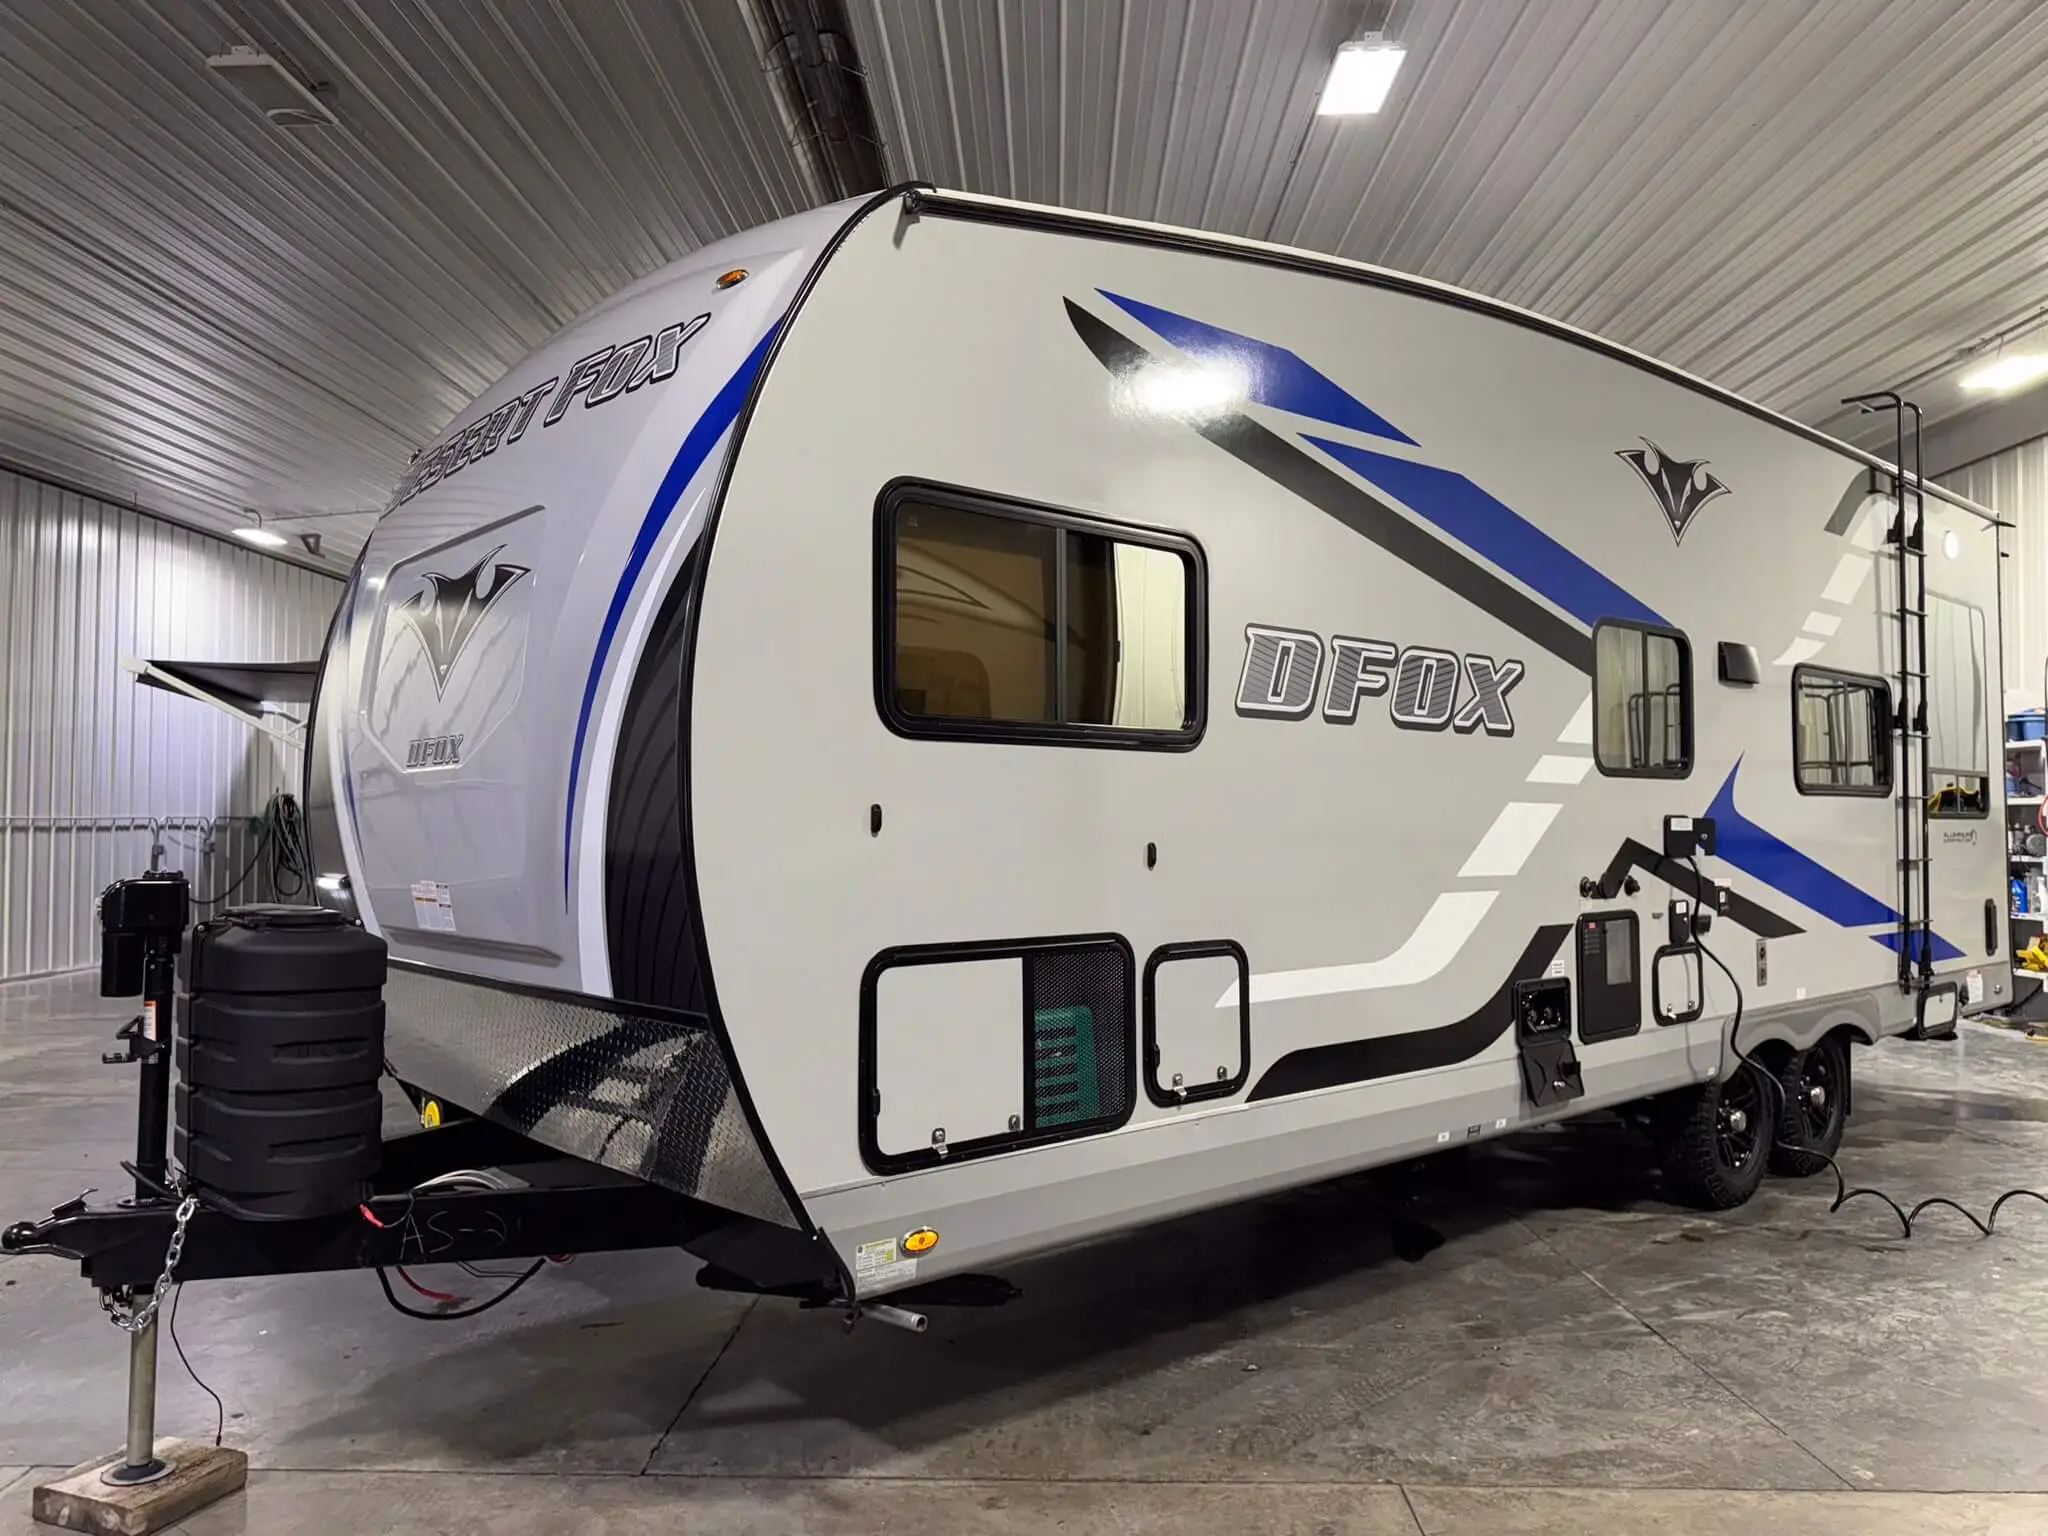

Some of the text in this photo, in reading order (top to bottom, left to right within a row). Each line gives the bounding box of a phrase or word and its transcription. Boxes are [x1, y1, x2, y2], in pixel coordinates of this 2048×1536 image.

[543, 312, 711, 428] FOX
[1235, 622, 1525, 738] DFOX
[406, 734, 464, 768] DFOX
